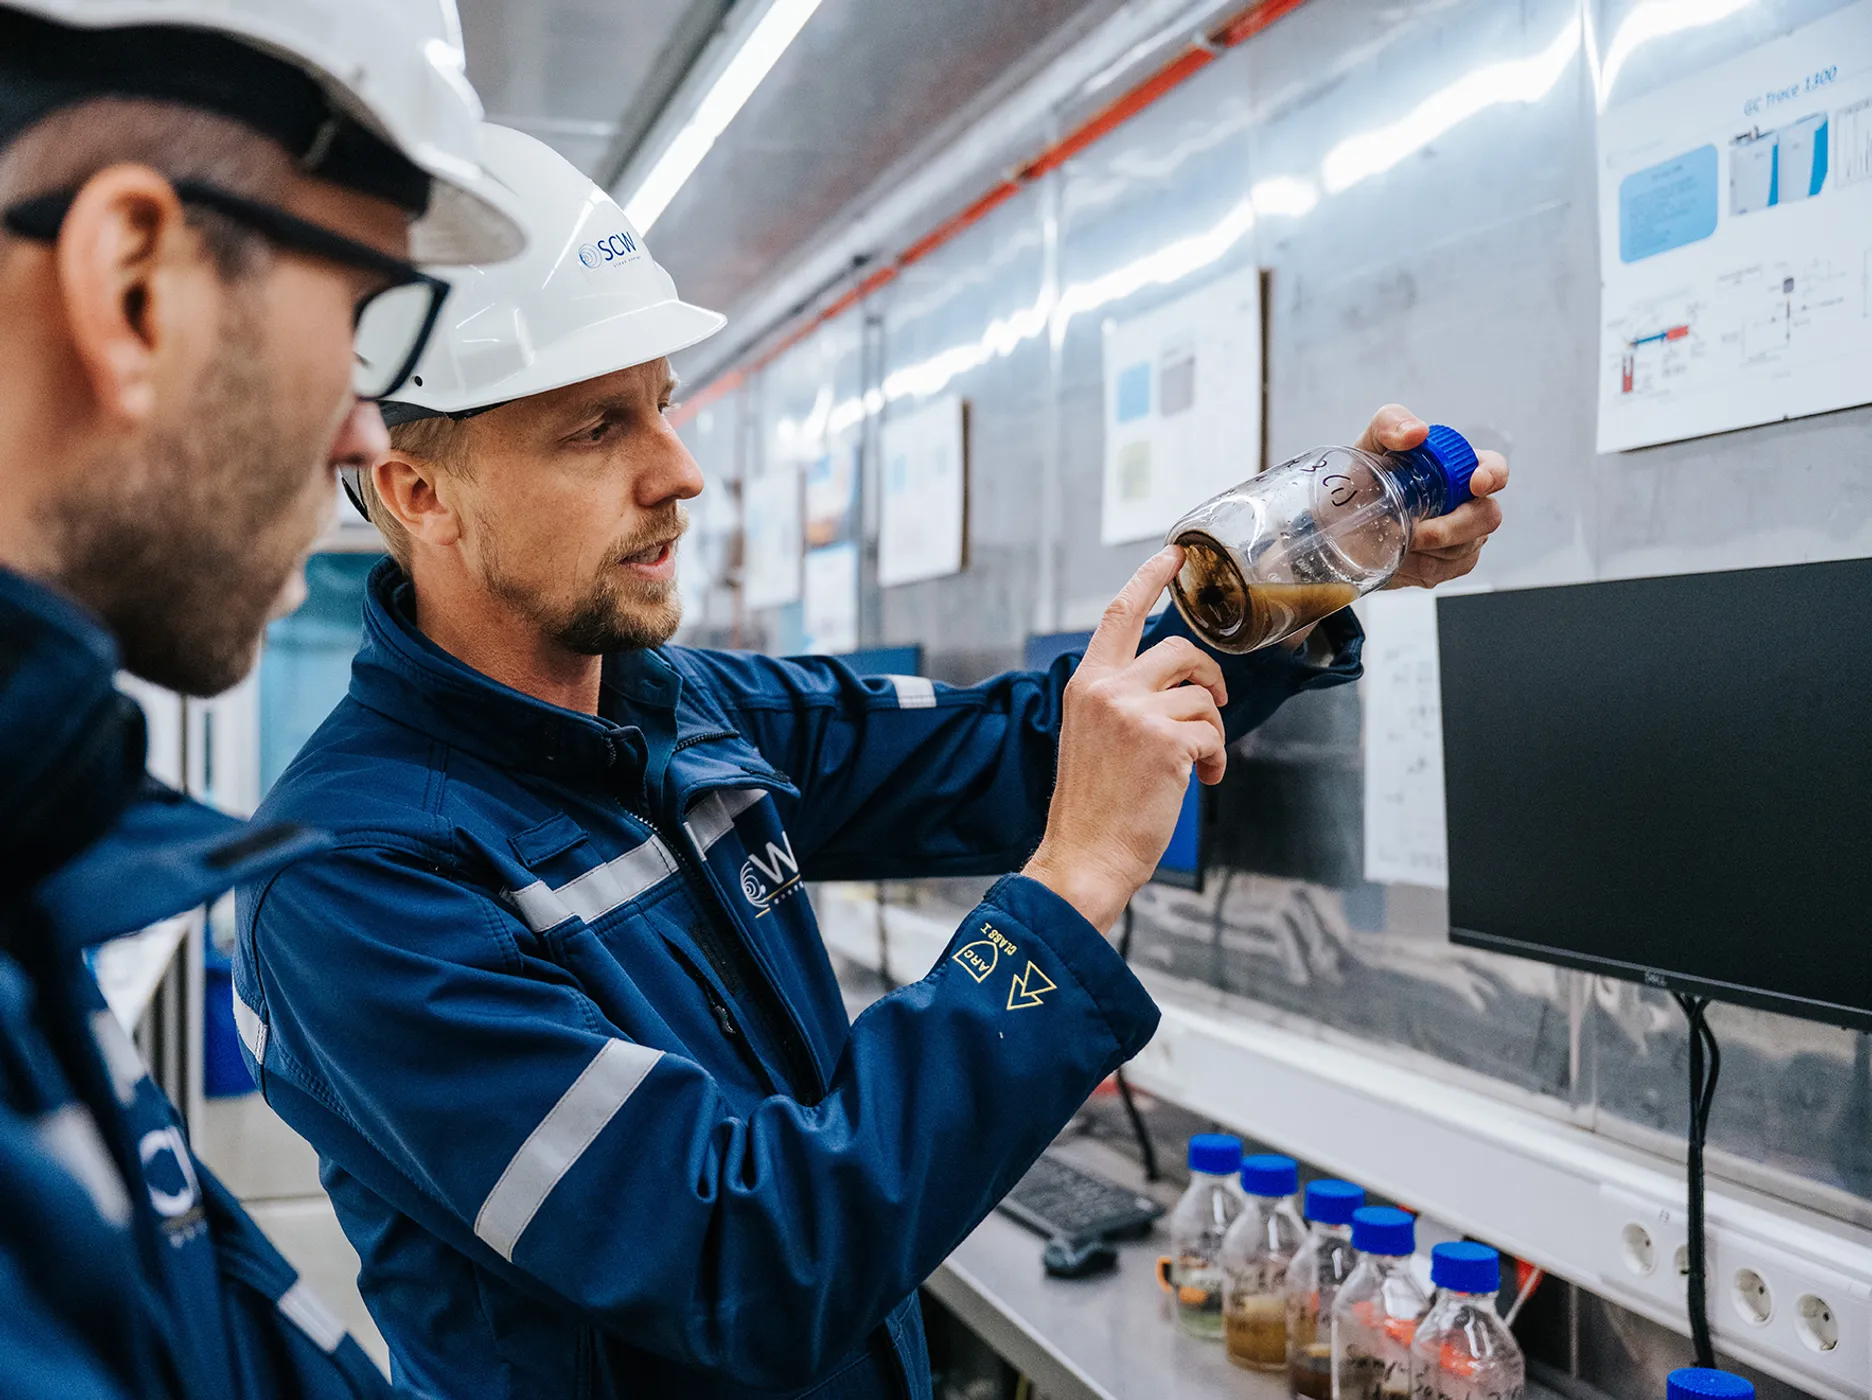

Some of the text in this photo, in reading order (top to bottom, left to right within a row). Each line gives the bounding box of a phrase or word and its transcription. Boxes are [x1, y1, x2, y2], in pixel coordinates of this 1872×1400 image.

[597, 231, 637, 261] SCW
[987, 928, 1018, 956] CLASS
[963, 949, 990, 972] ARC
